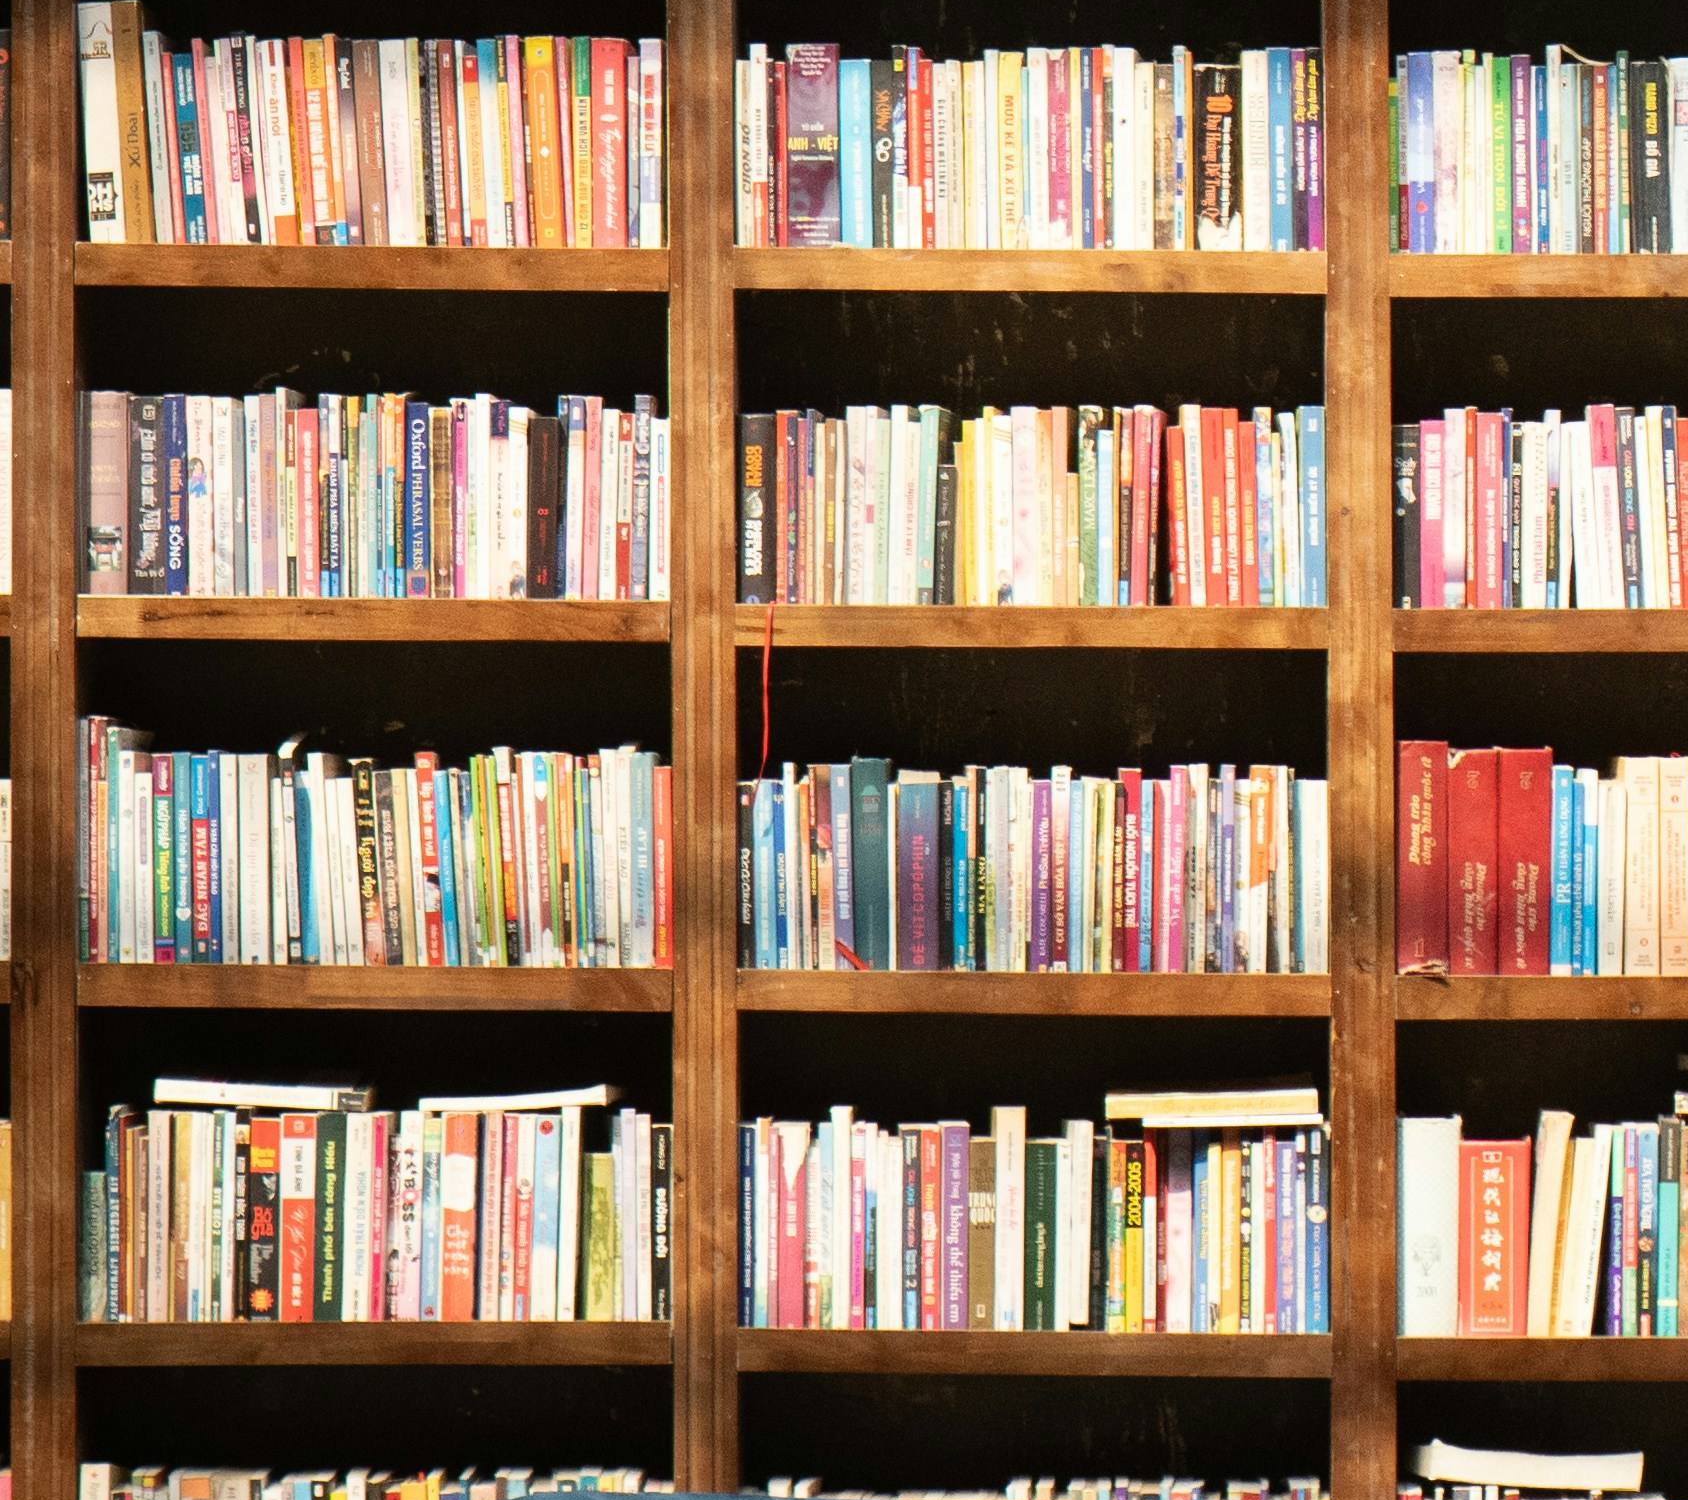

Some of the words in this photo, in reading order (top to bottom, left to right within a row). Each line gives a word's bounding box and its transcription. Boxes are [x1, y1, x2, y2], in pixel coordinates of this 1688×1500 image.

[787, 137, 808, 152] ANH
[814, 132, 839, 153] VIỆT
[1646, 140, 1658, 156] BỐ
[1645, 158, 1659, 178] GIÀ
[410, 419, 424, 471] Oxford
[745, 445, 754, 487] DOYLE
[753, 445, 763, 487] CONAN
[412, 473, 423, 530] PHRASAL
[413, 531, 424, 571] VERBS
[744, 519, 754, 576] HOLMES
[753, 519, 763, 575] SHERLOCK
[194, 827, 208, 858] TÂM
[195, 861, 208, 900] NHÂN
[109, 1176, 118, 1193] KIT
[324, 1173, 336, 1204] sông
[1128, 1161, 1142, 1226] 2004-2005
[110, 1198, 120, 1253] BIRTHDAY
[253, 1205, 272, 1223] Bố
[323, 1207, 334, 1233] bên
[946, 1205, 962, 1245] không
[321, 1235, 334, 1261] phố
[949, 1247, 962, 1267] thể
[110, 1257, 119, 1321] PAPERCRAFT
[322, 1263, 334, 1304] Thành
[948, 1270, 962, 1306] thiếu
[948, 1305, 959, 1323] em
